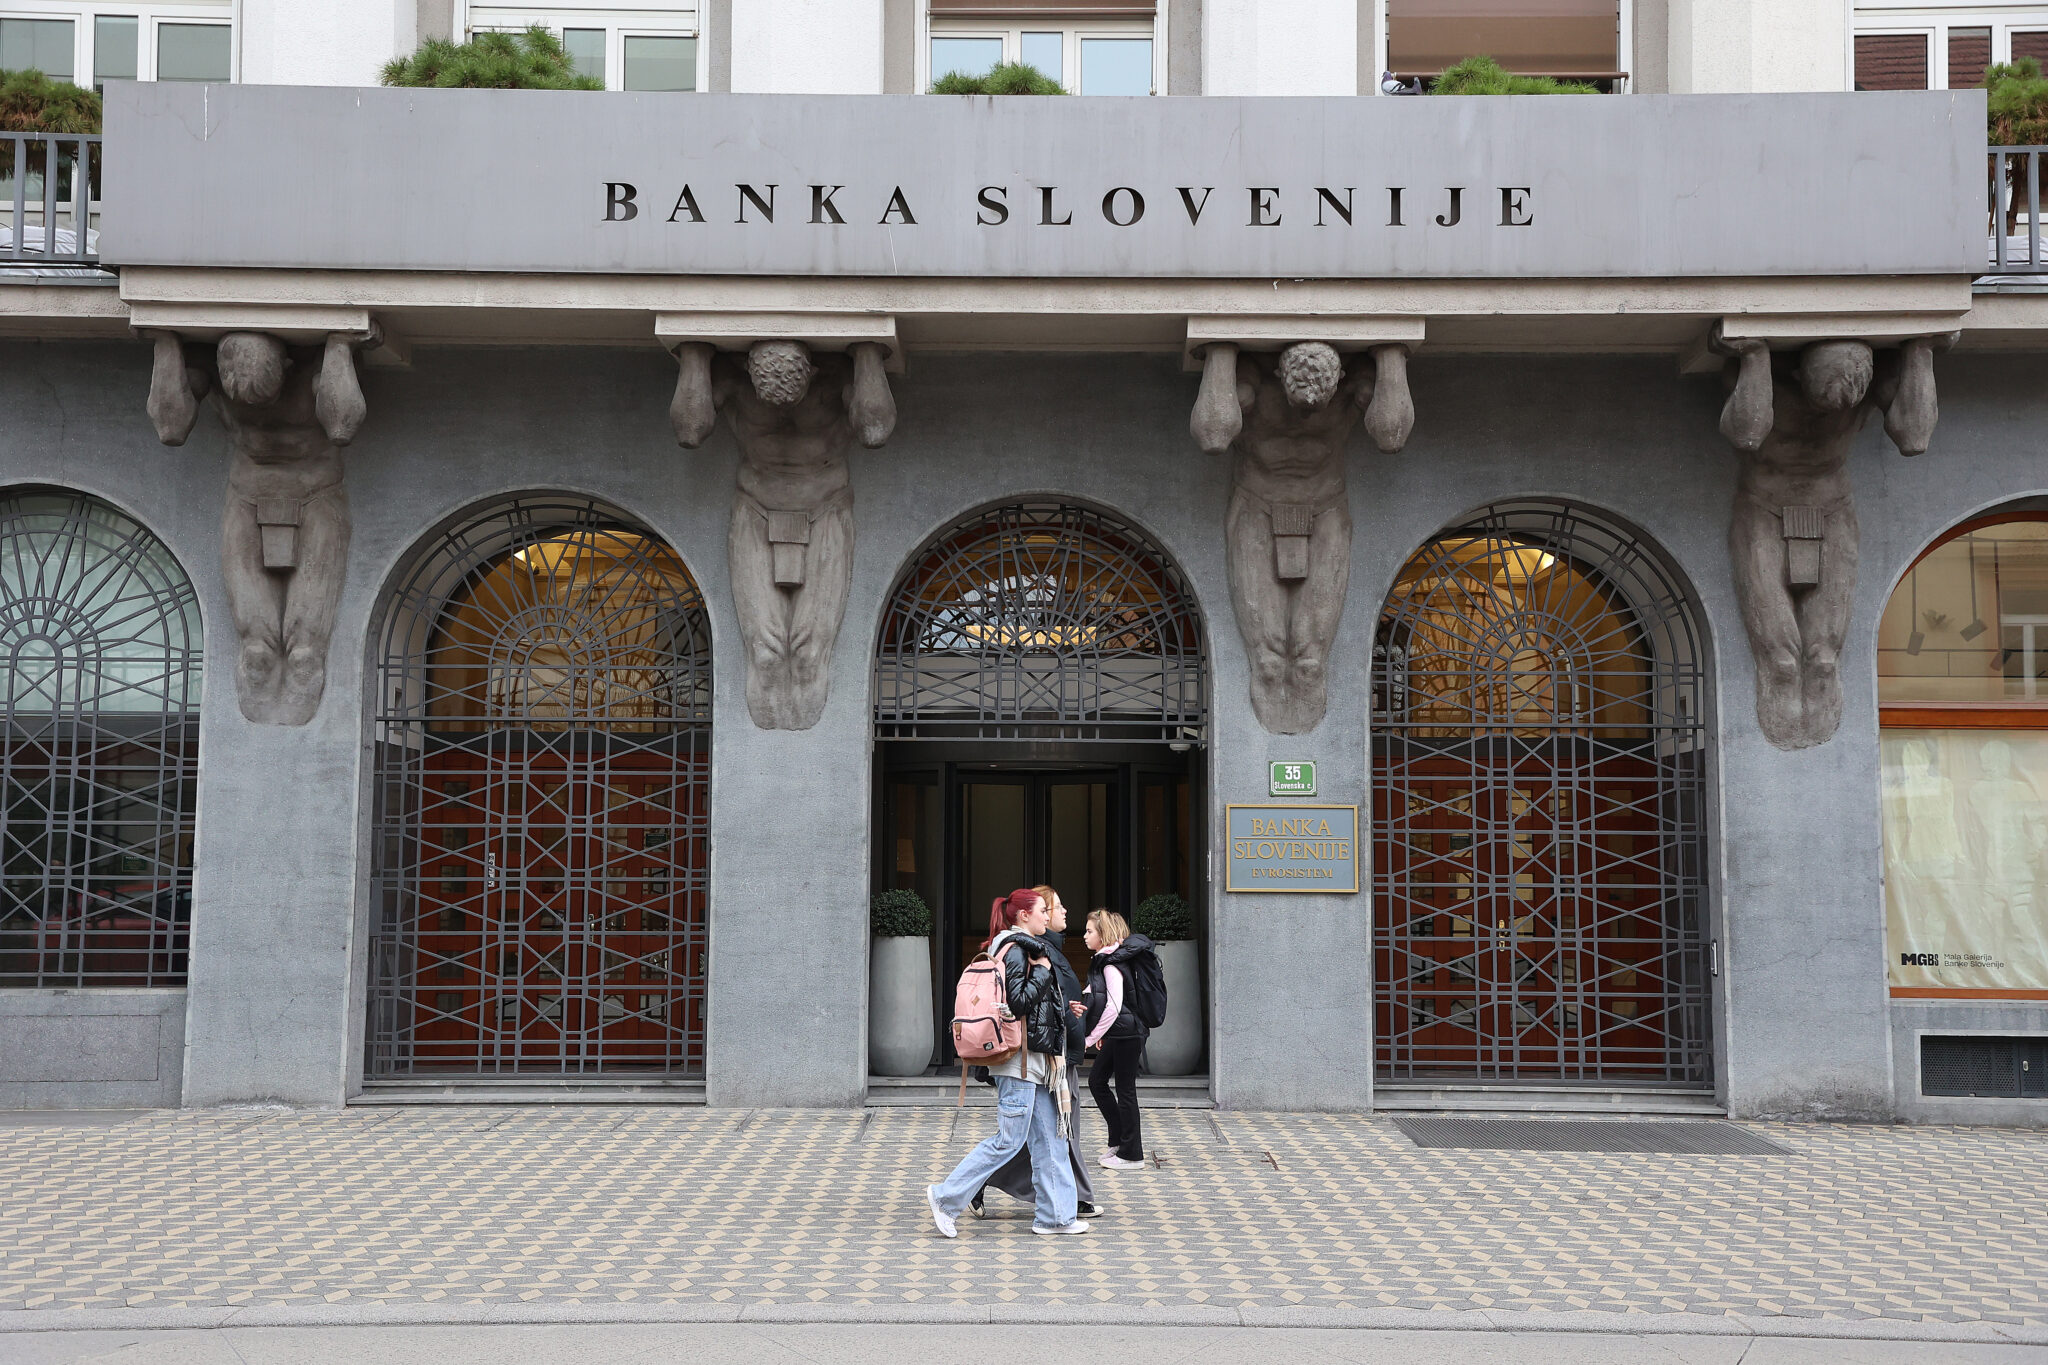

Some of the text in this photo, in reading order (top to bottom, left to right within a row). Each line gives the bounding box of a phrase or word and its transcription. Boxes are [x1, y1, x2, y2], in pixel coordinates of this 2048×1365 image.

[601, 182, 1534, 227] BANKA SLOVENIJE
[1284, 765, 1301, 780] 35
[1274, 781, 1305, 789] Slovenska
[1251, 818, 1333, 836] BANKA
[1234, 841, 1350, 860] SLOVENIJE
[1251, 868, 1333, 879] EVROSISTEM
[1901, 953, 1939, 967] MGBS
[1963, 953, 1993, 962] Galerija
[1970, 960, 2005, 969] Slovenije
